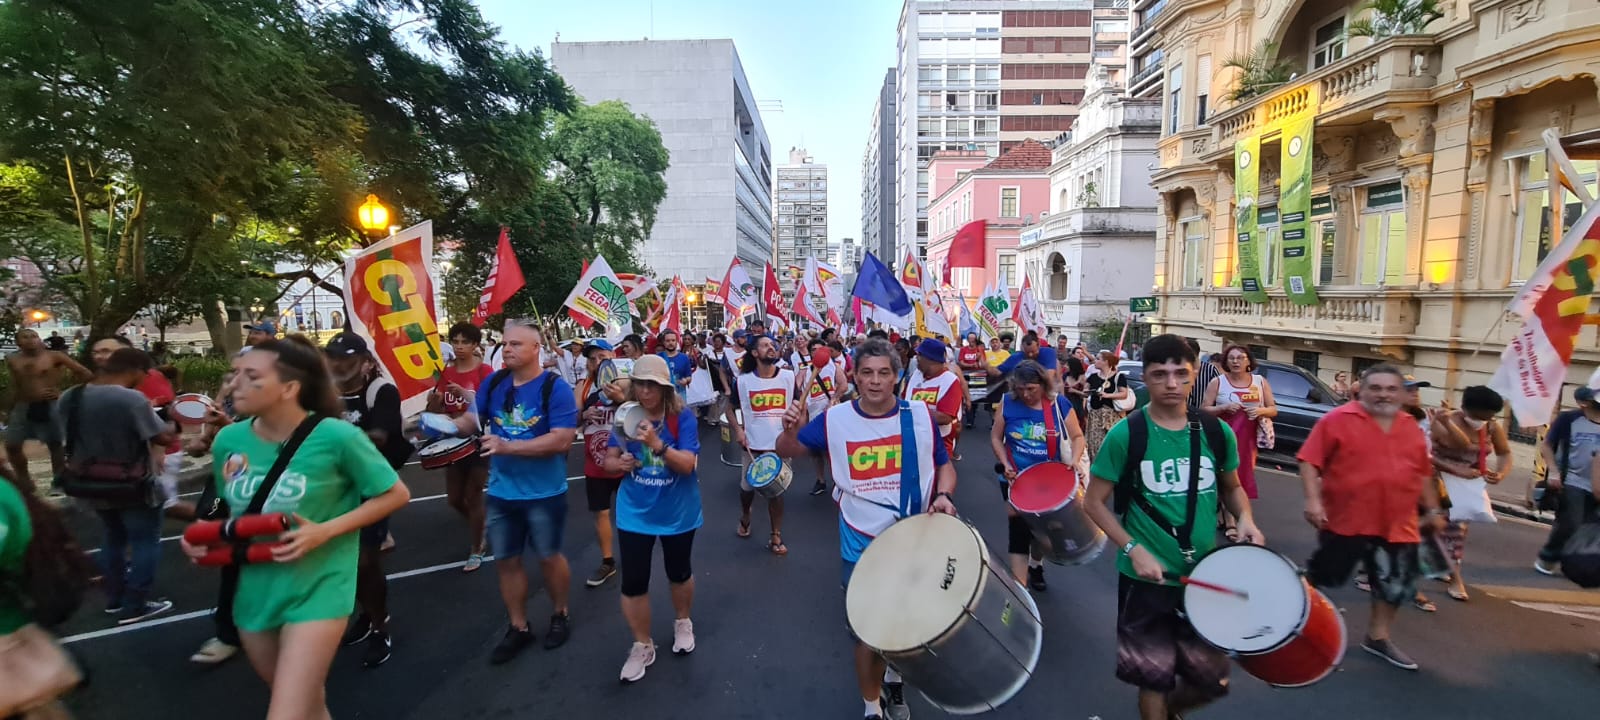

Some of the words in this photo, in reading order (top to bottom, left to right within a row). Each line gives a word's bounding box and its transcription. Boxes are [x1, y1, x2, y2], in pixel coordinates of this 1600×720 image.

[583, 287, 610, 312] FEGA
[364, 258, 446, 381] CTB
[751, 393, 786, 407] CTB
